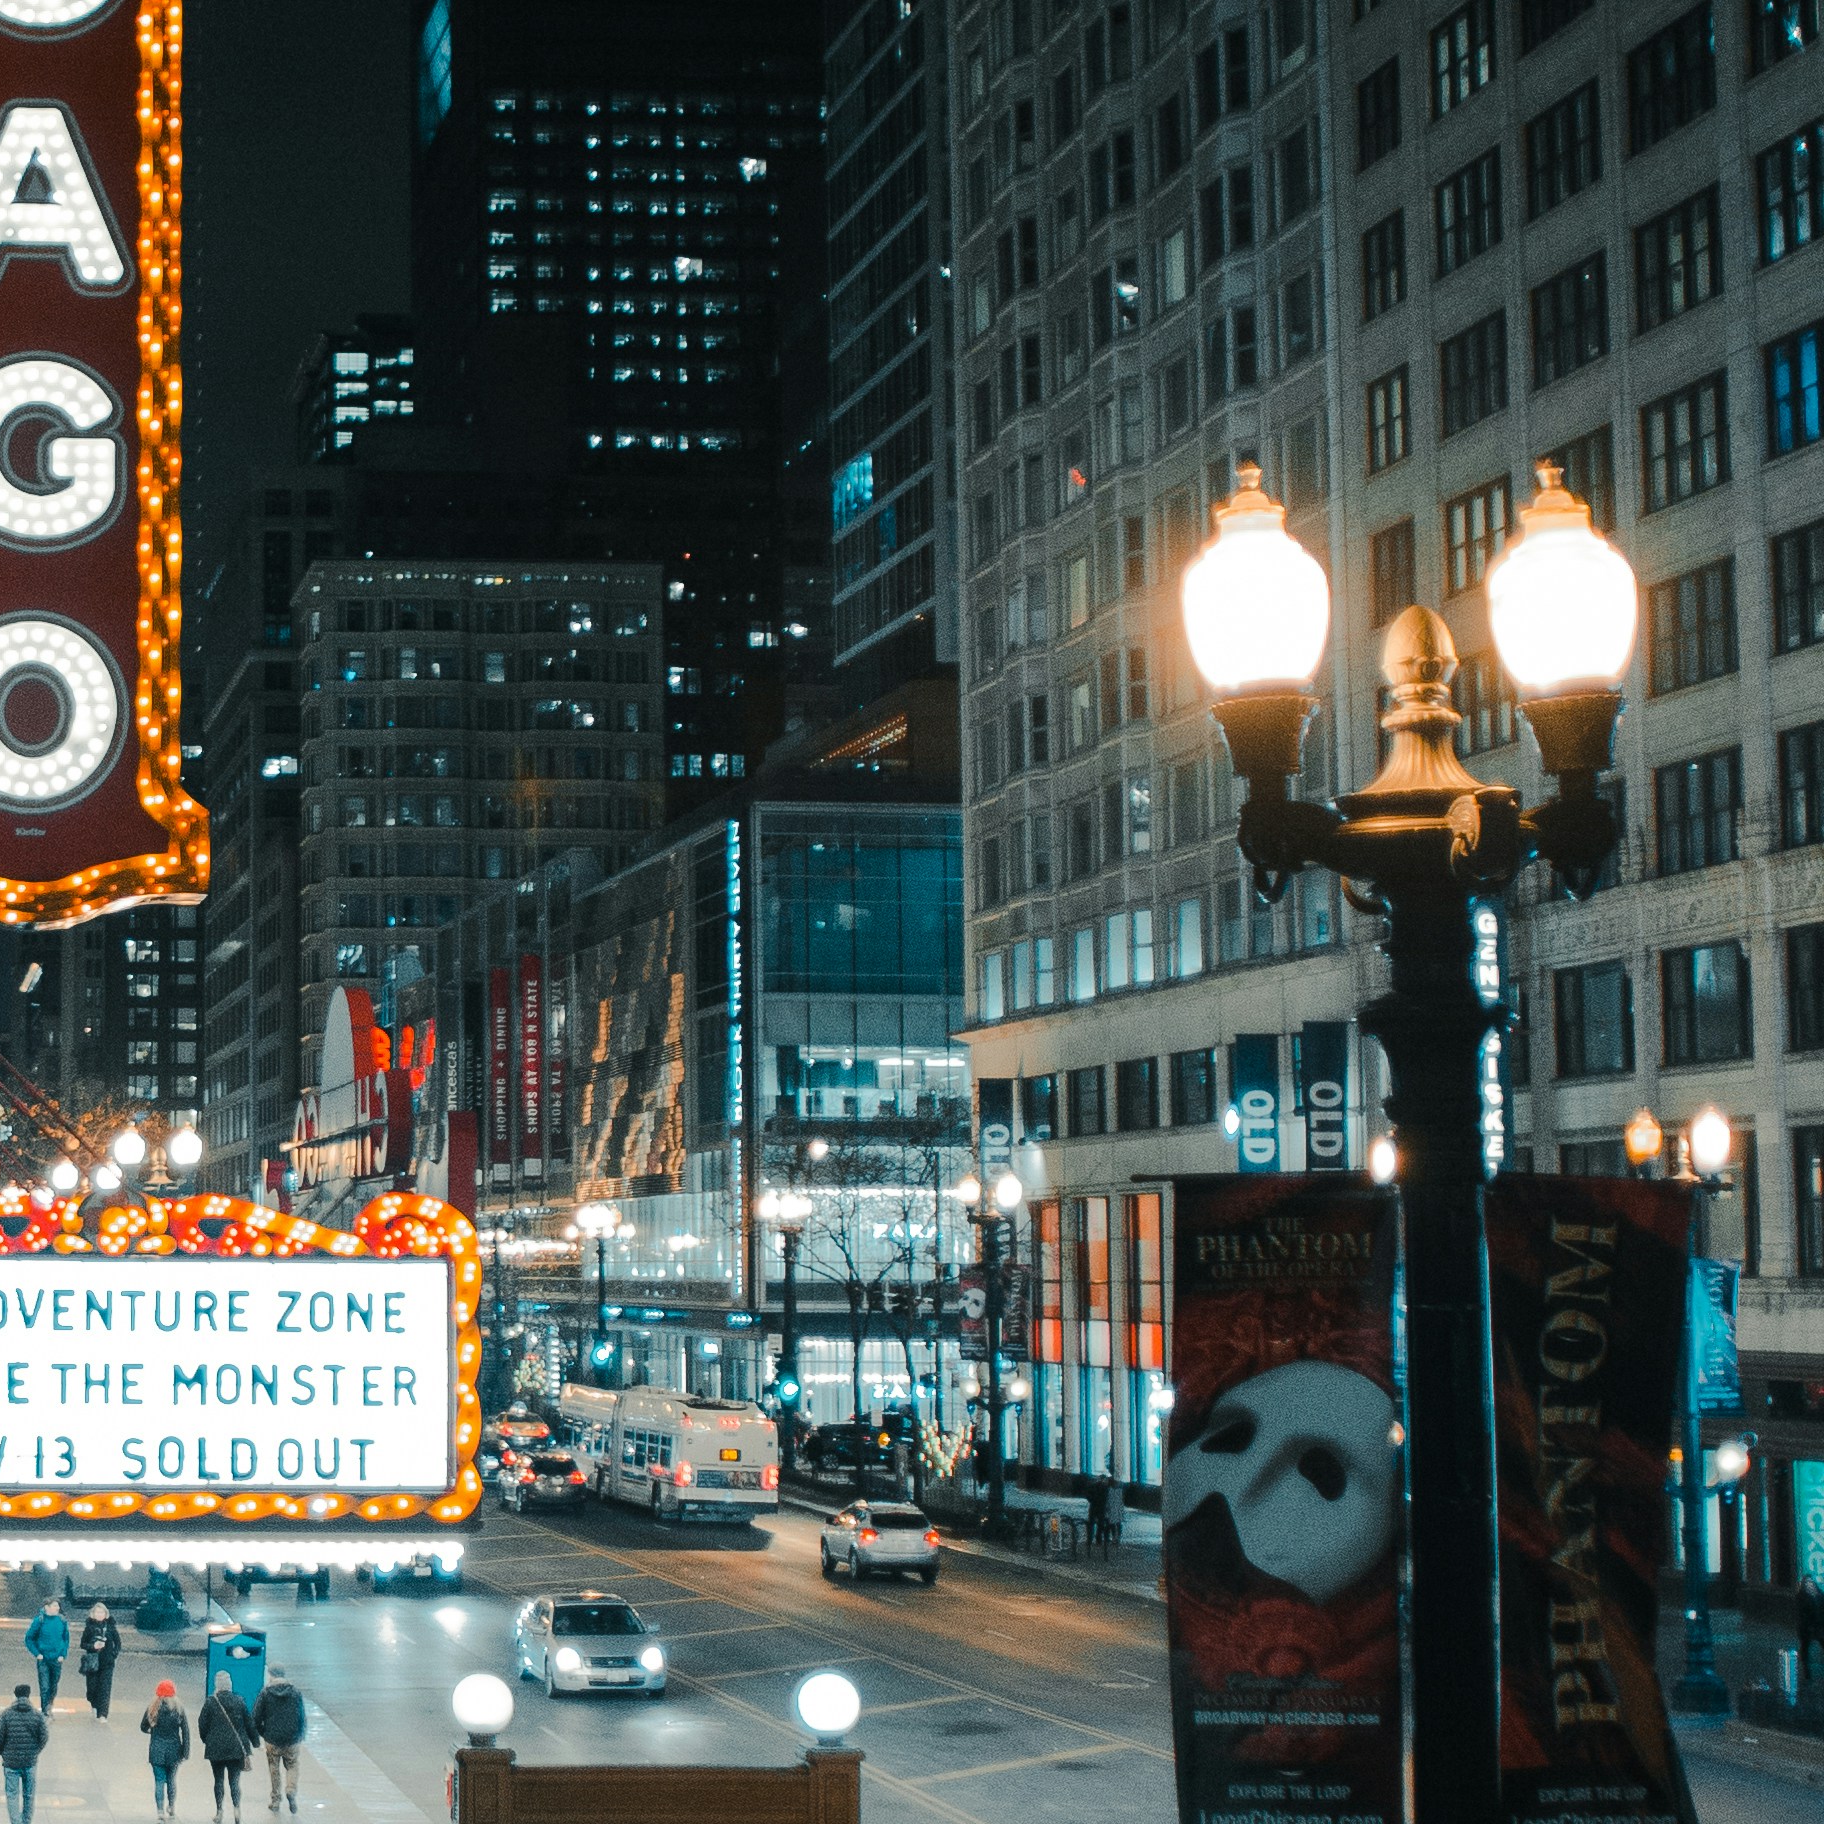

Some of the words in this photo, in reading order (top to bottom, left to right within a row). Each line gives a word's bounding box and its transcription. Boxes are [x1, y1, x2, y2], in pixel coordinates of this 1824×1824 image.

[728, 819, 743, 914] SEVEN
[728, 920, 743, 1017] THIRTY
[1477, 912, 1500, 998] GEN
[526, 979, 538, 1019] STATE
[495, 1006, 507, 1051] DINING
[526, 1024, 537, 1033] N
[526, 1038, 538, 1063] 108
[444, 1040, 457, 1111] ancesca's
[526, 1069, 538, 1086] AT
[728, 1025, 744, 1123] BLOCK
[495, 1077, 507, 1141] SHOPPING
[526, 1091, 538, 1134] SHOPS
[1240, 1089, 1276, 1164] OLD
[1307, 1080, 1344, 1157] OLD
[1263, 1216, 1305, 1233] THE
[1195, 1232, 1374, 1263] PHANTOM
[1210, 1264, 1236, 1279] OF
[1245, 1262, 1284, 1278] THE
[1287, 1261, 1357, 1278] OPERA
[276, 1291, 407, 1334] ZONE
[51, 1363, 144, 1405] THE
[172, 1363, 419, 1407] MONSTER
[872, 1384, 937, 1399] ZA
[35, 1435, 78, 1478] 13
[121, 1436, 258, 1481] SOLD
[277, 1438, 376, 1481] OUT
[1534, 1213, 1621, 1731] PHANTOM
[1805, 1465, 1824, 1585] cricke
[1227, 1783, 1286, 1800] EXPLORE
[1289, 1783, 1313, 1800] THE
[1317, 1784, 1351, 1800] LOOP
